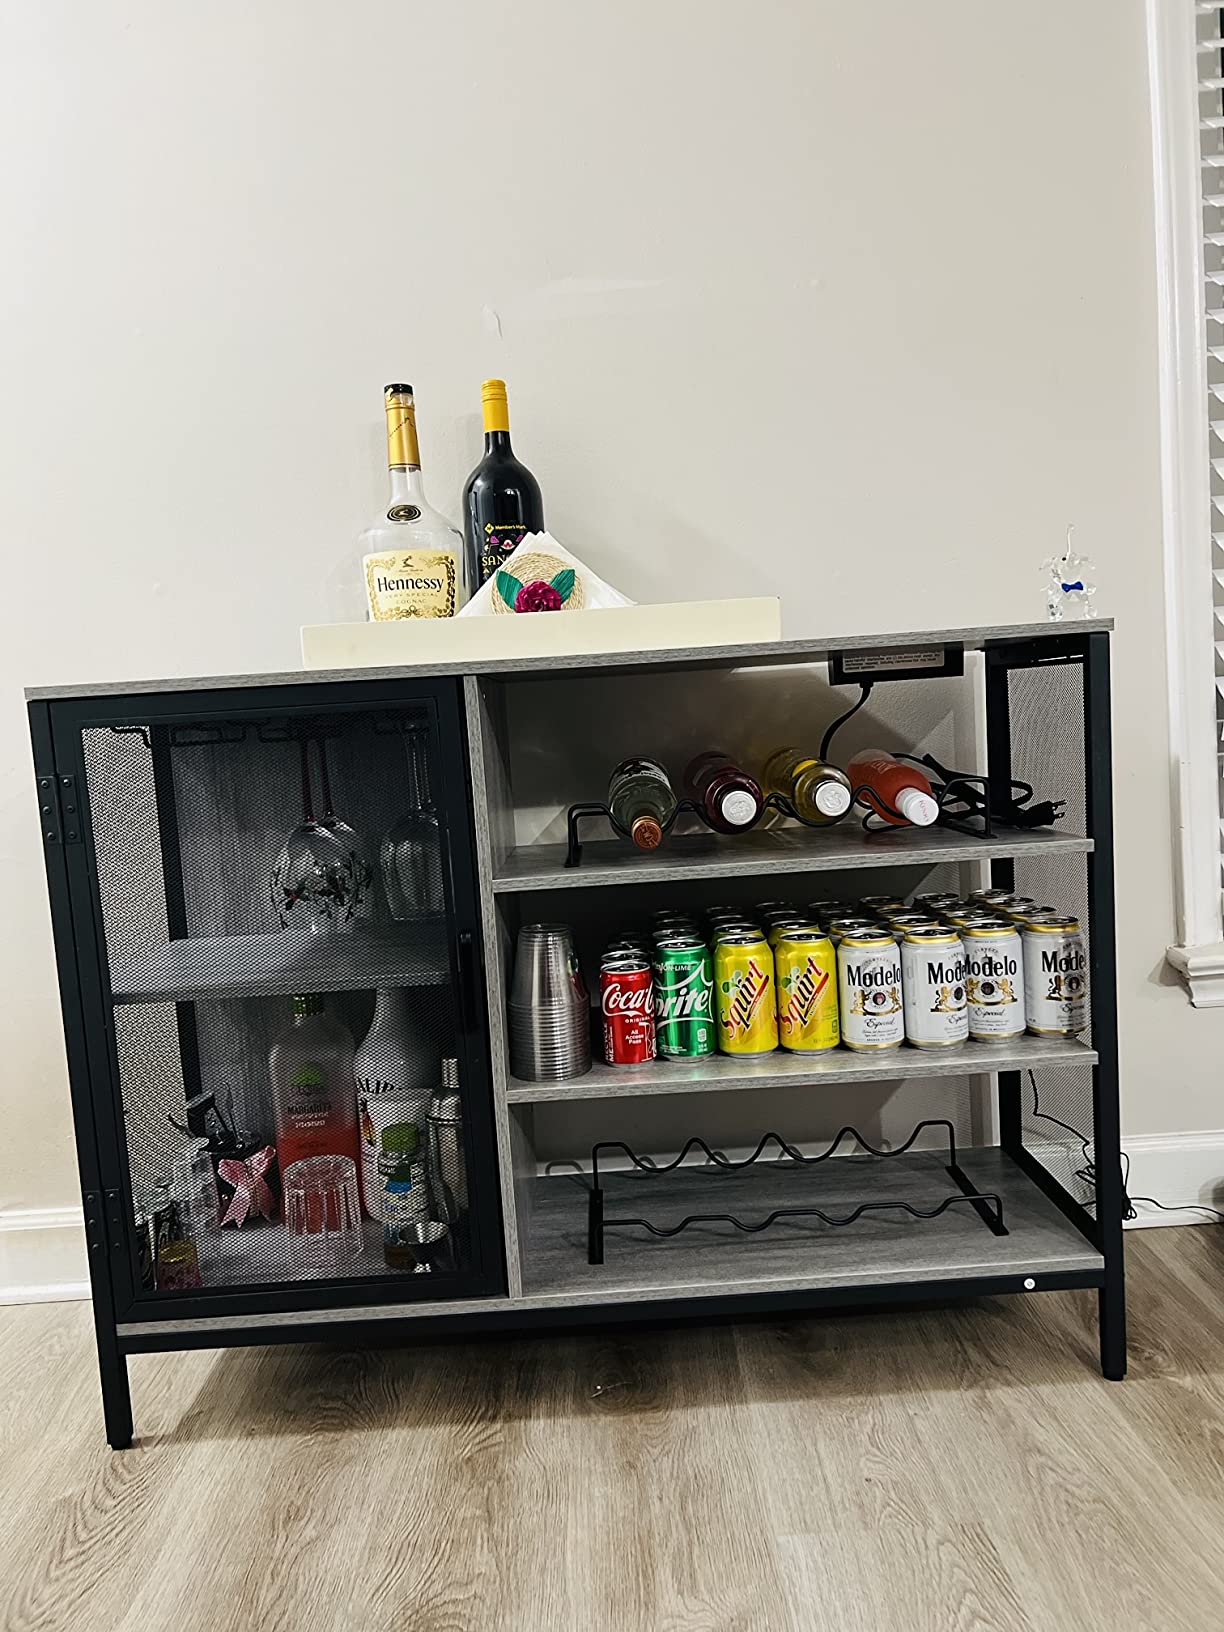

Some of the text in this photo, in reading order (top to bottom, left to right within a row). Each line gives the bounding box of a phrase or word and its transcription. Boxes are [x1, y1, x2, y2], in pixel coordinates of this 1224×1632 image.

[482, 554, 509, 567] SAN
[377, 576, 444, 593] Hennessy
[927, 960, 966, 985] Mode
[1041, 950, 1085, 973] Mode
[720, 959, 764, 1039] Squirt
[779, 957, 822, 1035] Squirt
